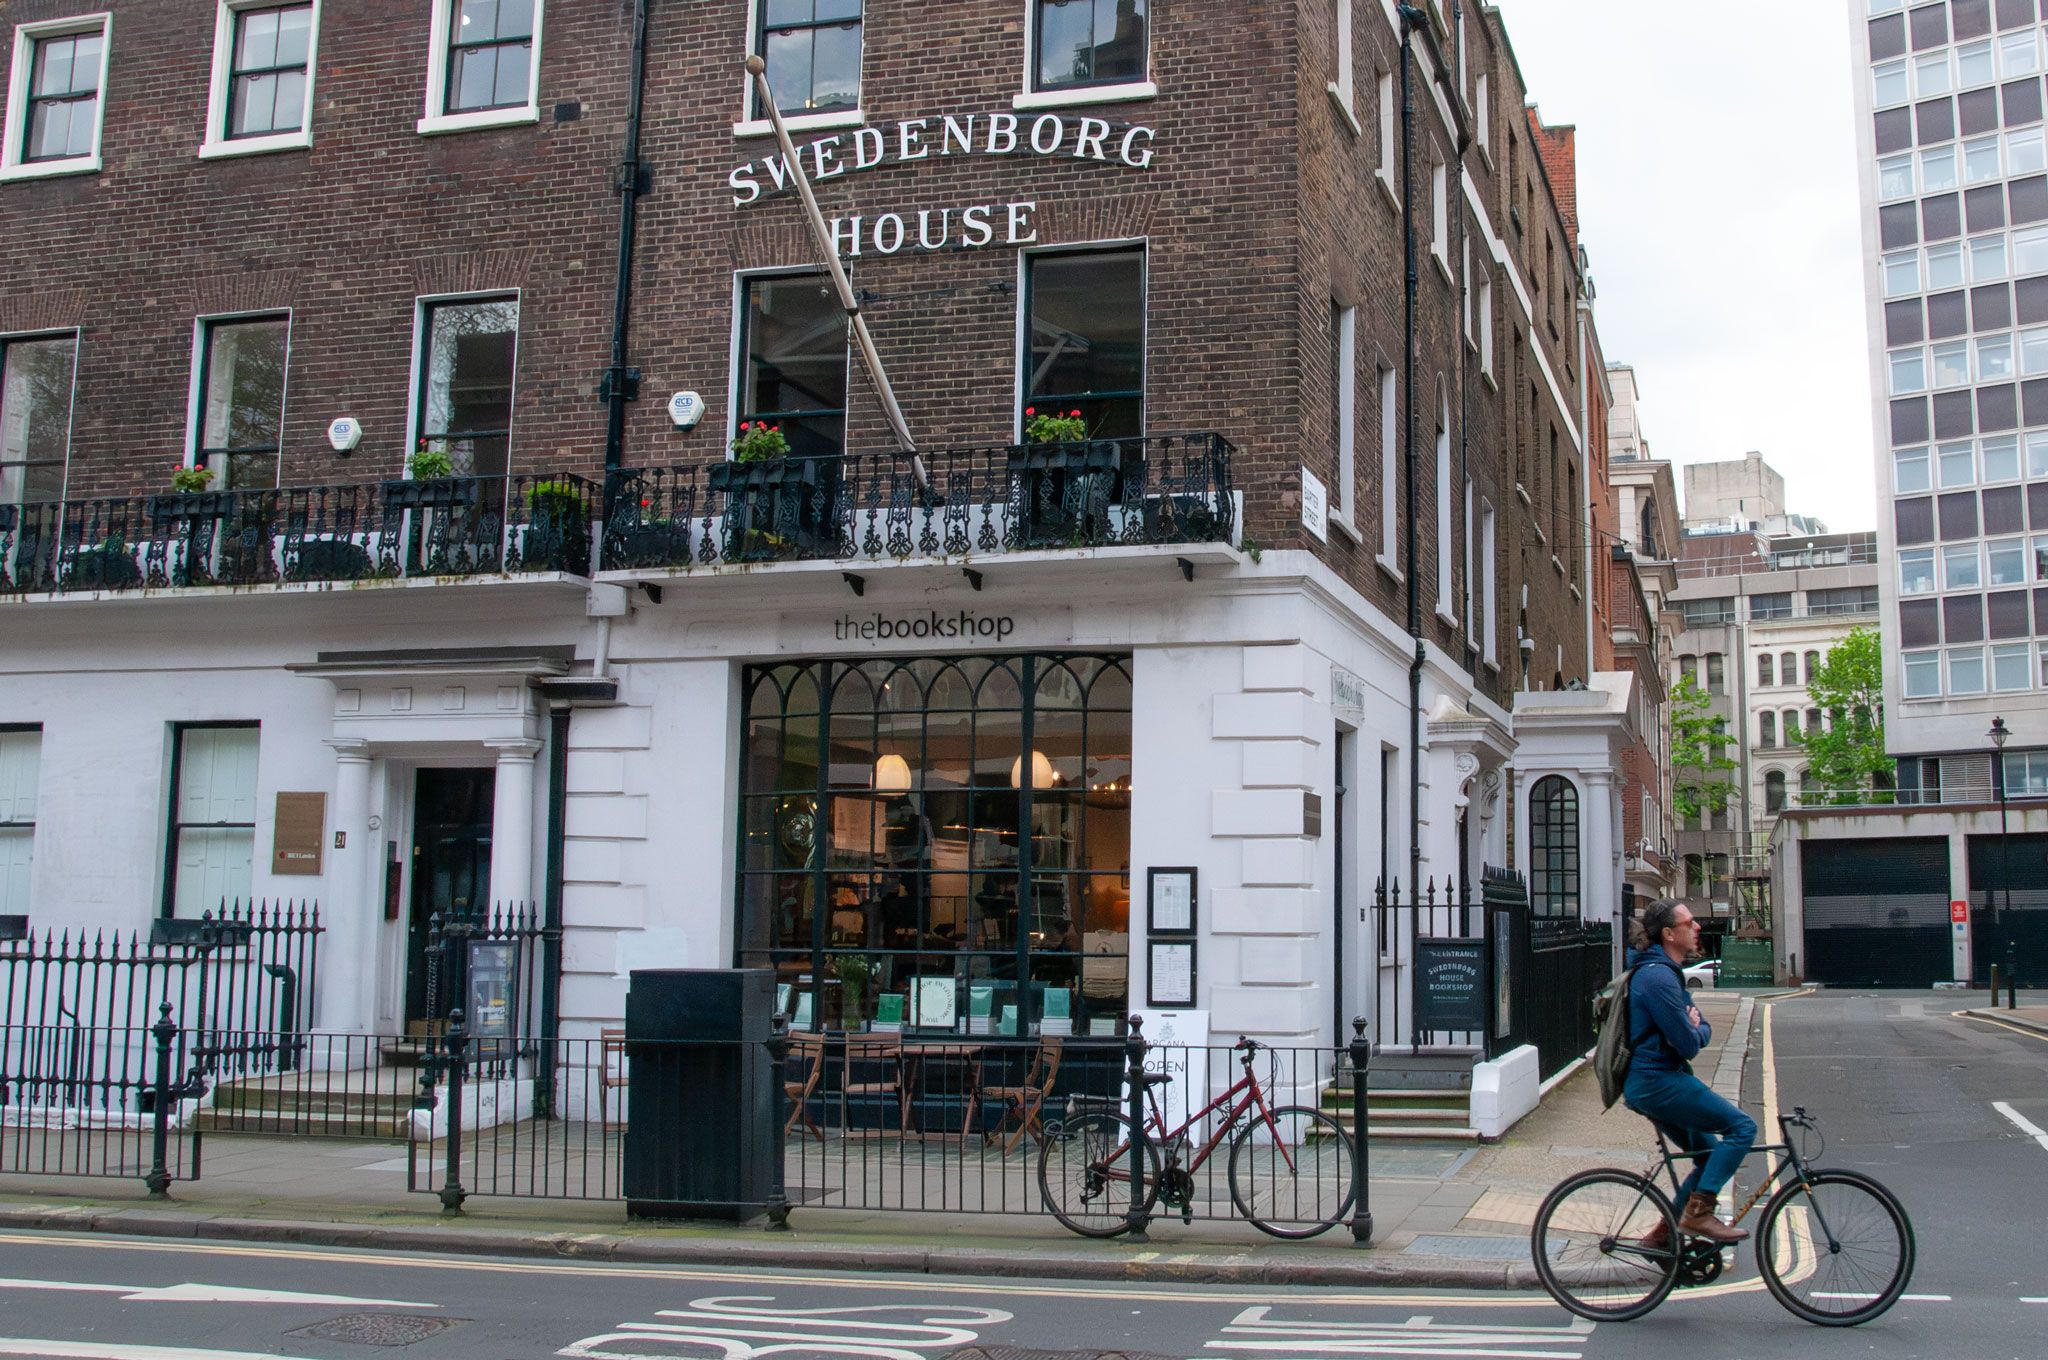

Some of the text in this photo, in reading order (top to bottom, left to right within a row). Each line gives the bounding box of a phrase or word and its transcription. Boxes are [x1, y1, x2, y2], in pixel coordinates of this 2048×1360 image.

[728, 113, 1156, 209] SWEDENBORG
[829, 201, 1037, 257] HOUSE
[834, 610, 1014, 642] thebookshop
[1428, 963, 1477, 976] SWEDENBORG
[1439, 974, 1464, 982] HOUSE
[1429, 983, 1474, 991] BOOKSHOP
[1146, 1039, 1186, 1047] ARCANA
[1144, 1060, 1185, 1073] OPEN
